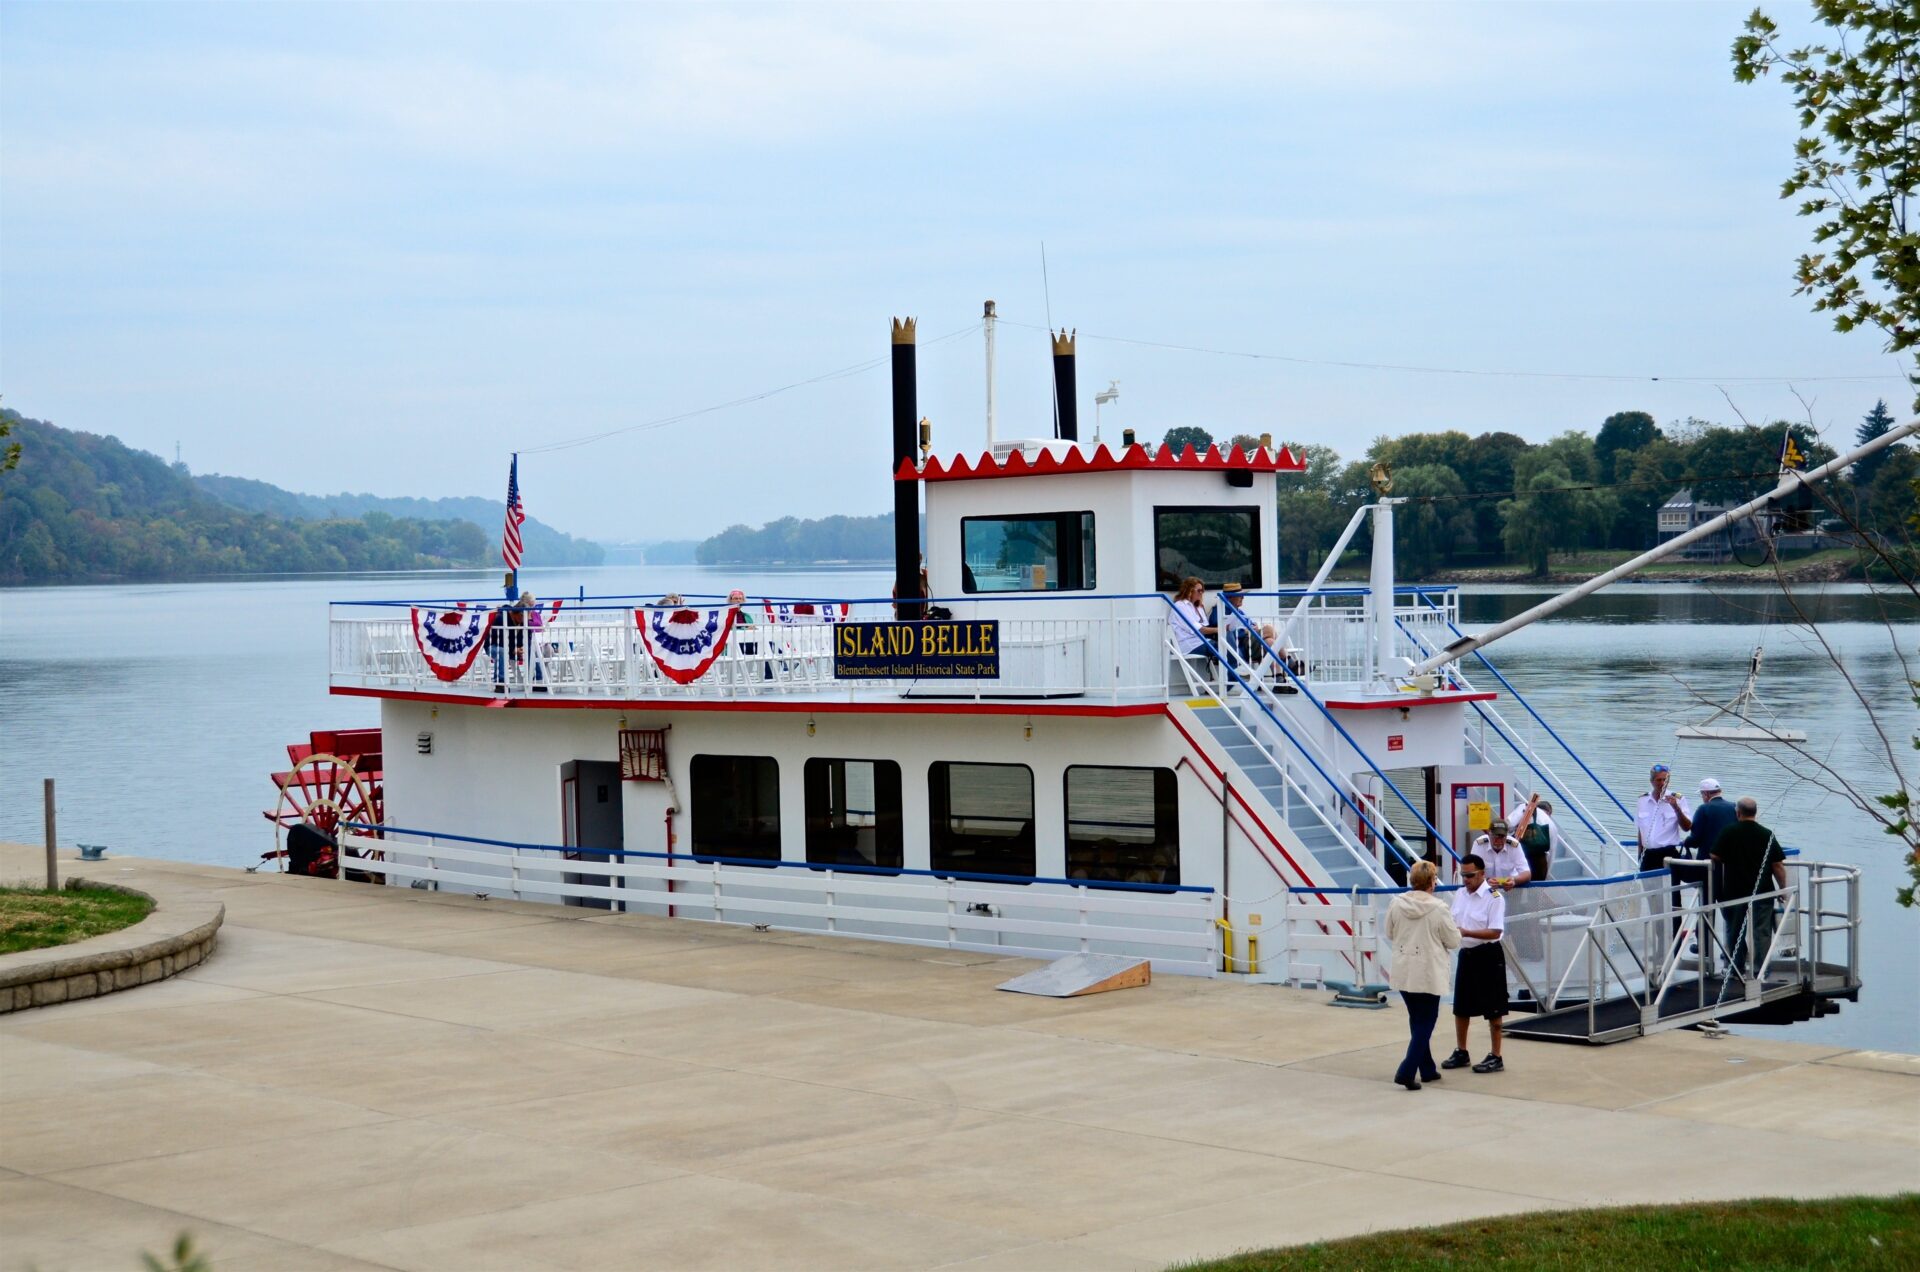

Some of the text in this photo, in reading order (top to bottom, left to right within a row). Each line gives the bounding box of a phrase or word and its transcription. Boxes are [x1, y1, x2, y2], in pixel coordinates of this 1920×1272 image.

[836, 624, 996, 657] ISLAND BELLE
[837, 664, 996, 676] Blennerhassett Island Historical State Park
